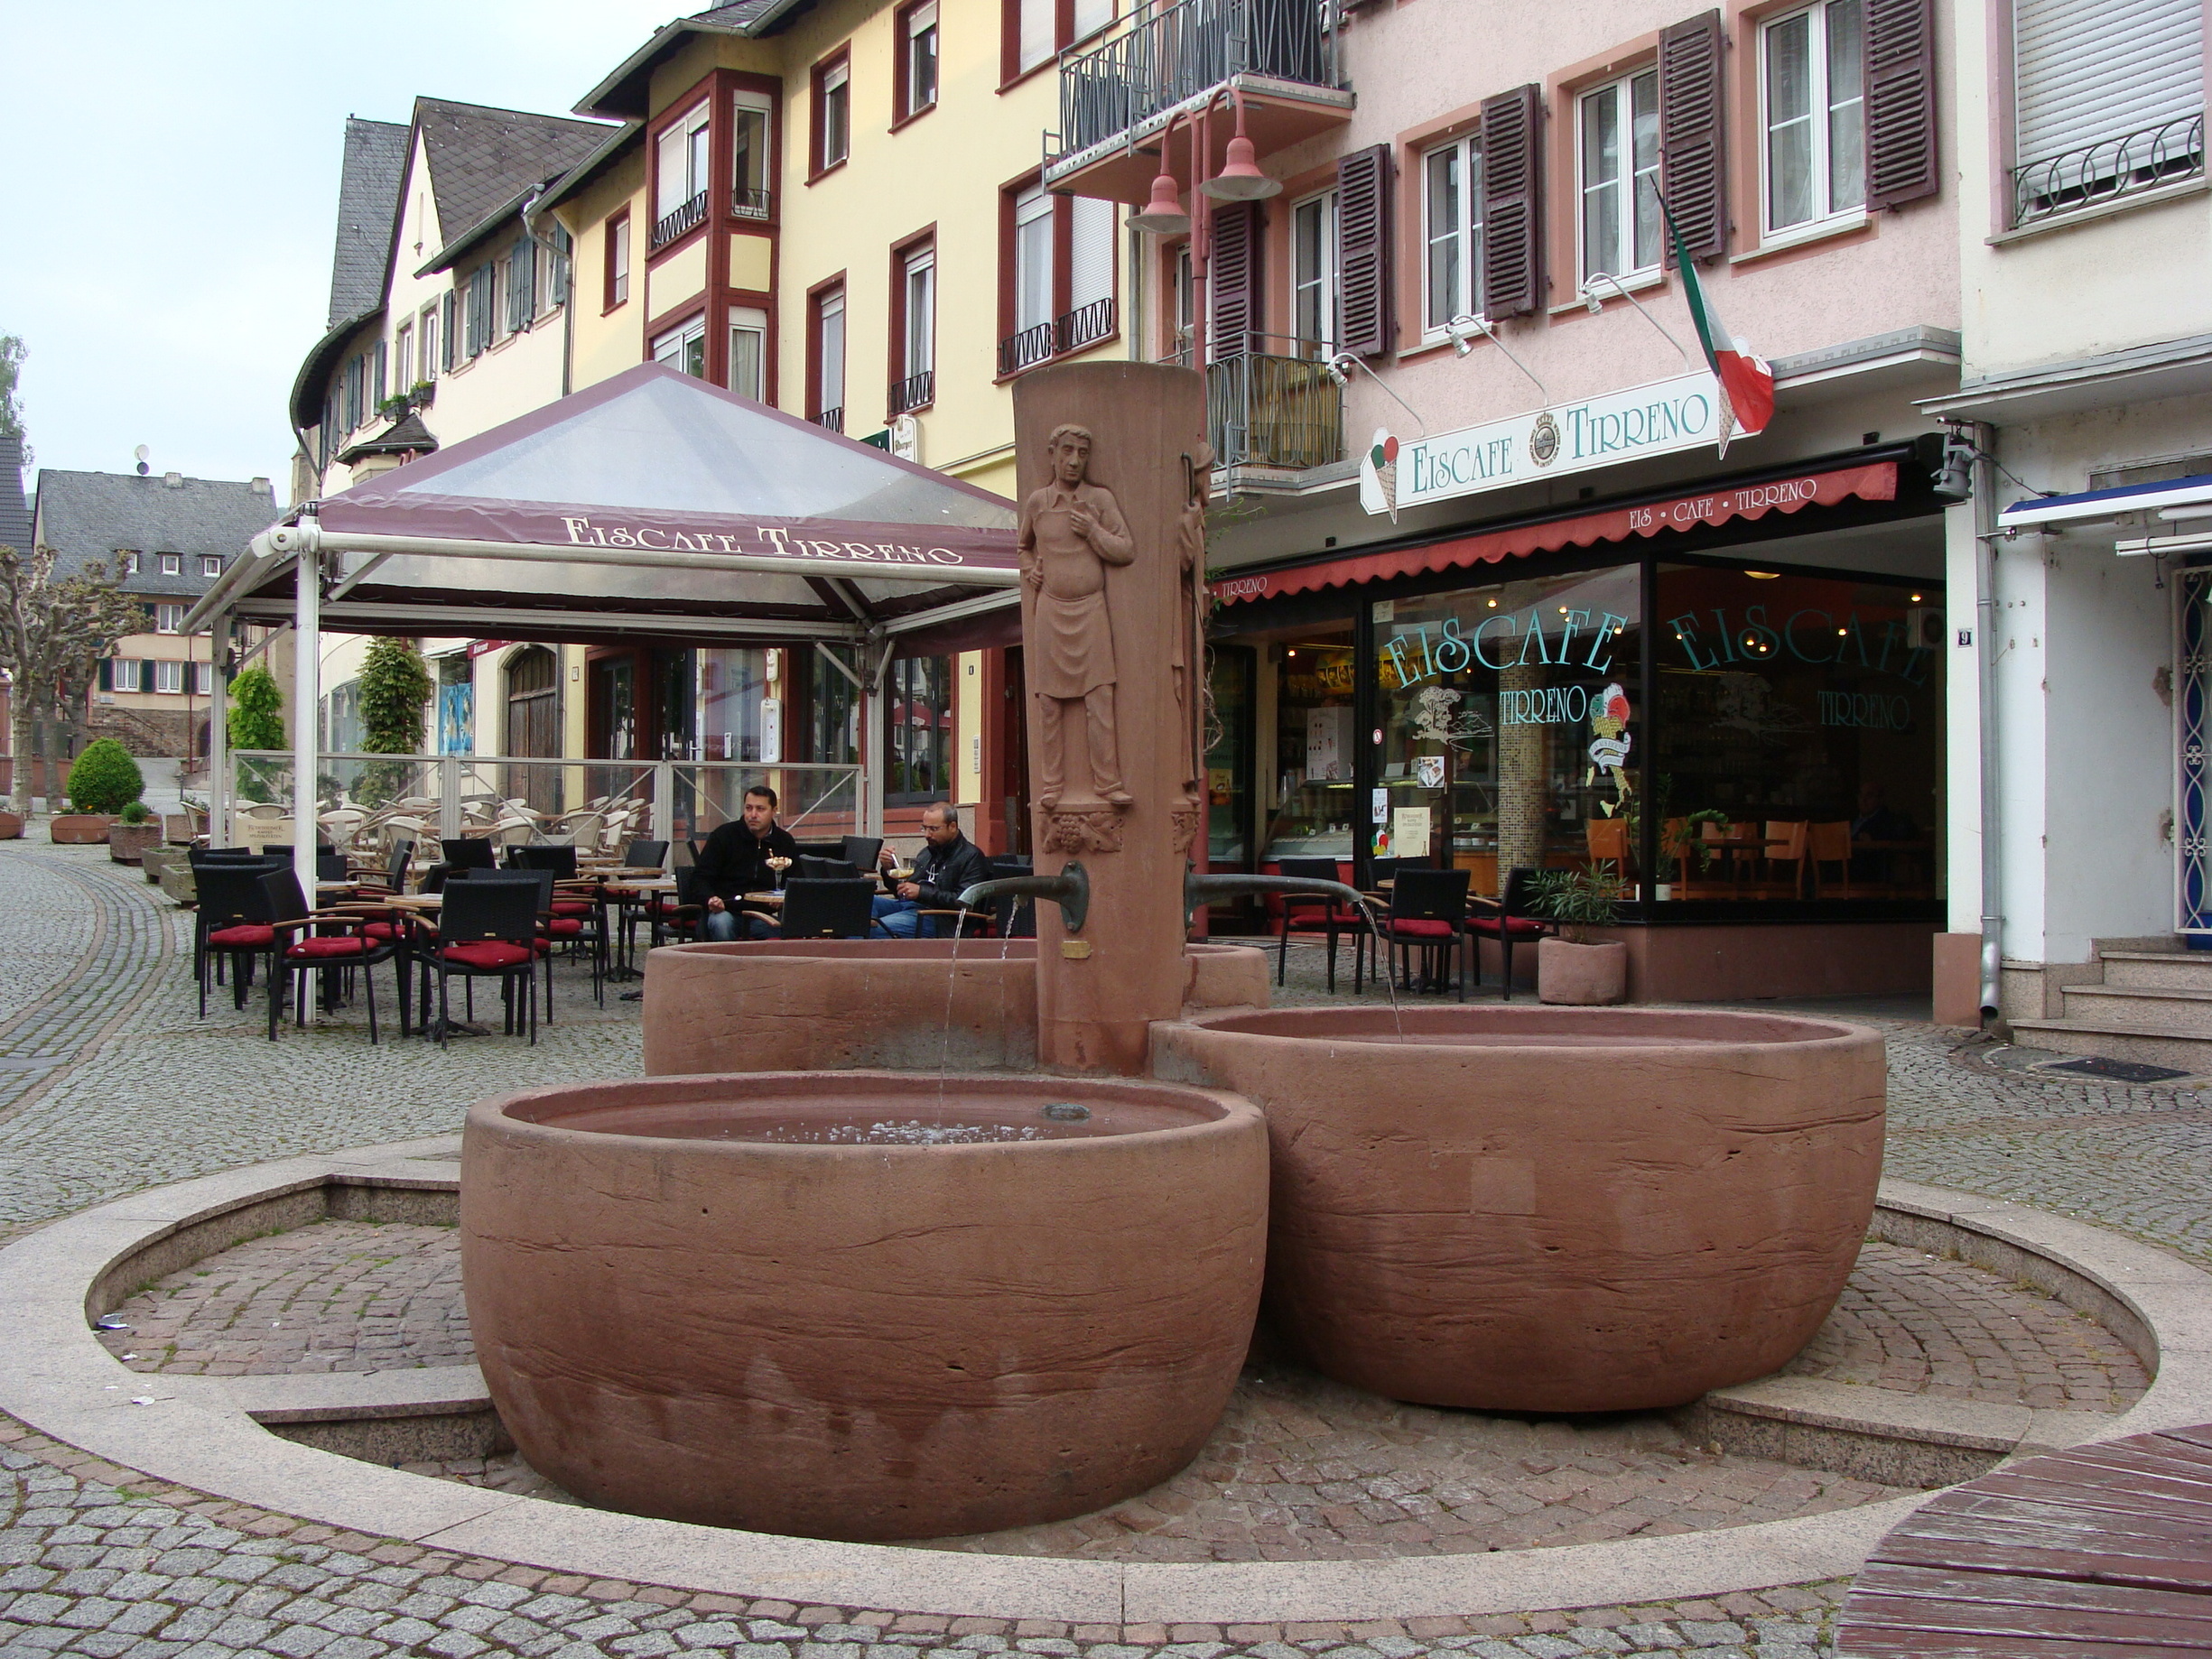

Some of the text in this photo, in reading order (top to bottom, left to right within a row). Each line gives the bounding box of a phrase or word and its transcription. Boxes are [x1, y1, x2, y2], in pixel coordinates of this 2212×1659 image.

[1411, 394, 1709, 494] EISCAFE TIRRENO
[1630, 479, 1817, 529] EIS CAFE TIRRENO
[561, 516, 963, 565] EISCAFE TIRRENO
[1222, 577, 1268, 598] TIRRENO
[1384, 607, 1629, 689] EISCAFE
[1667, 604, 1935, 688] EISCAFE
[1961, 631, 1968, 644] 9
[1500, 685, 1586, 726] TIRRENO
[1817, 690, 1910, 730] TIRRENO
